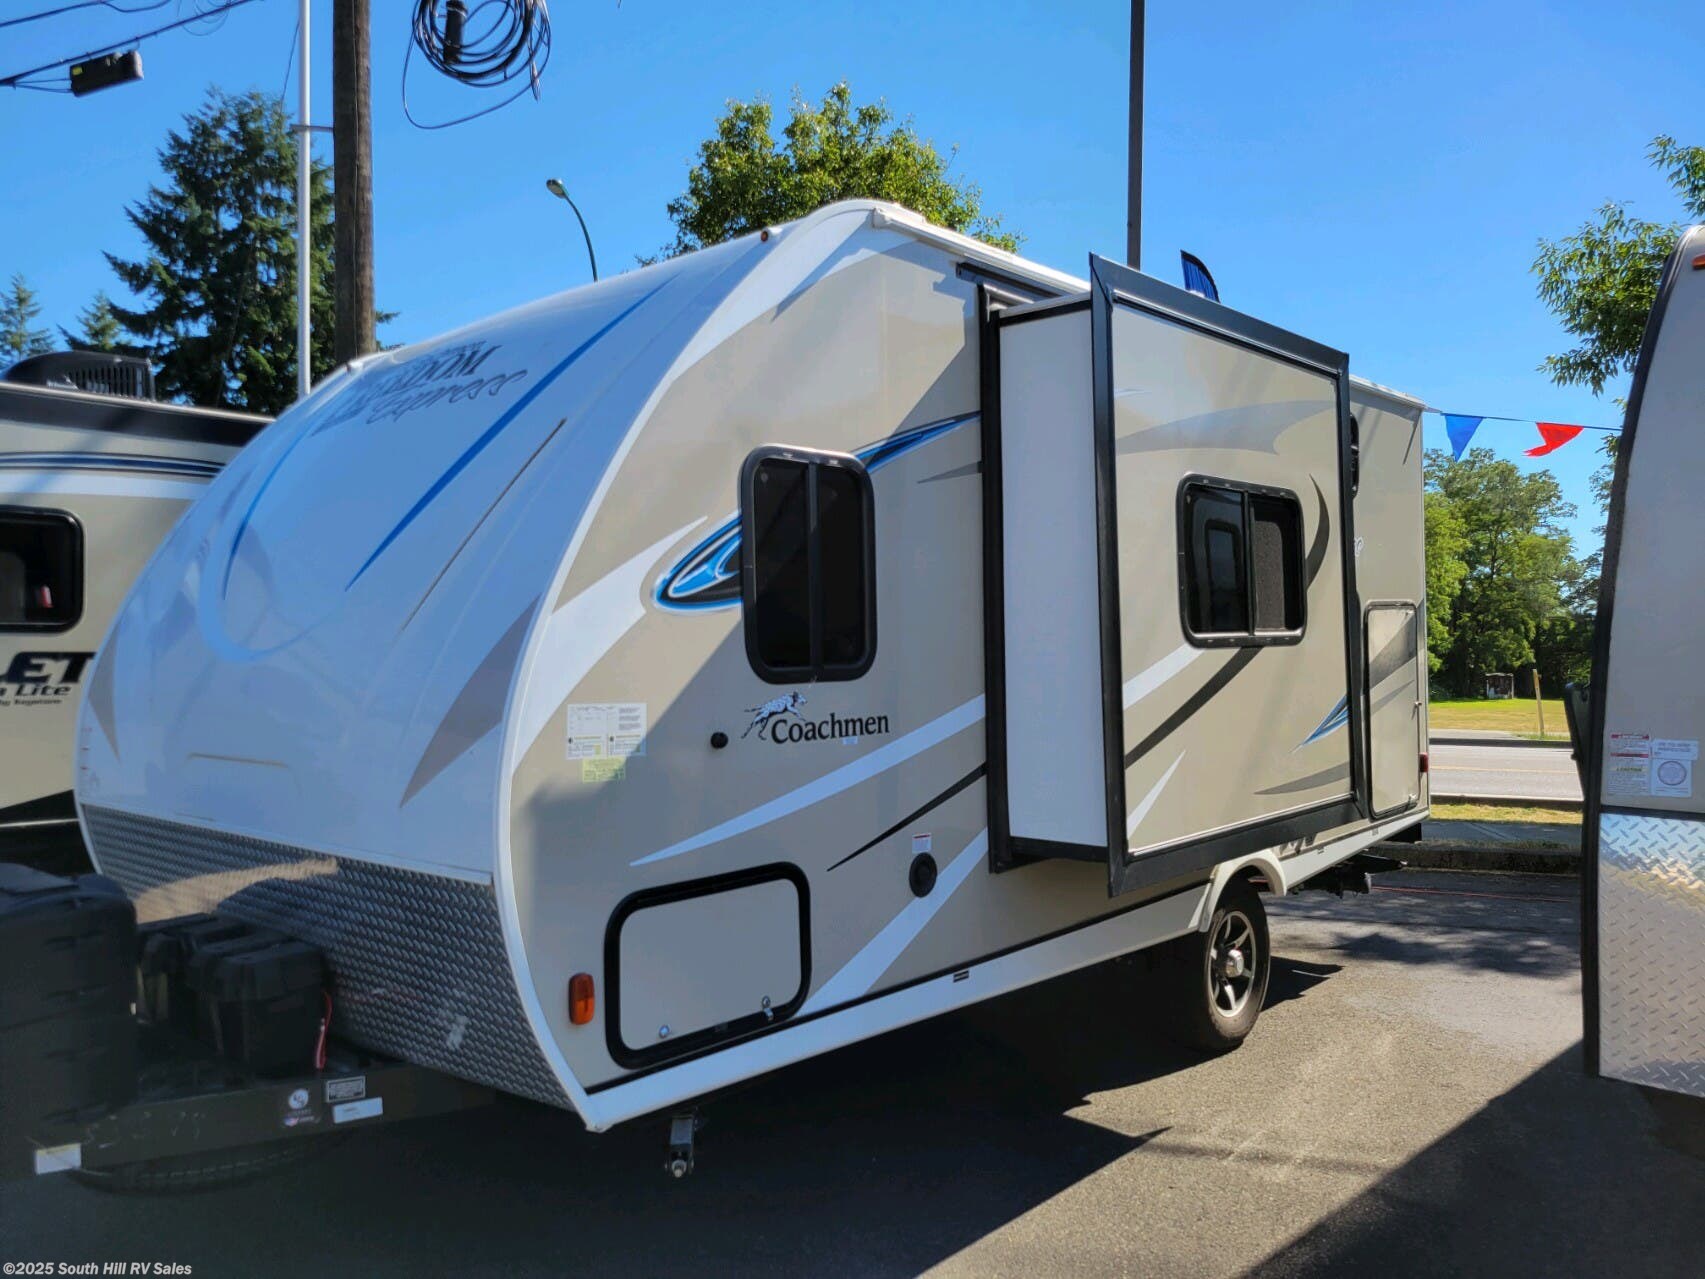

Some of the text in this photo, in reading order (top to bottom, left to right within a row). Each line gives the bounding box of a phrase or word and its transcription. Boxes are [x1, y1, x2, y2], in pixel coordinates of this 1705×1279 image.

[0, 651, 98, 684] ET
[15, 684, 72, 696] Lite
[770, 711, 890, 744] Coachmen
